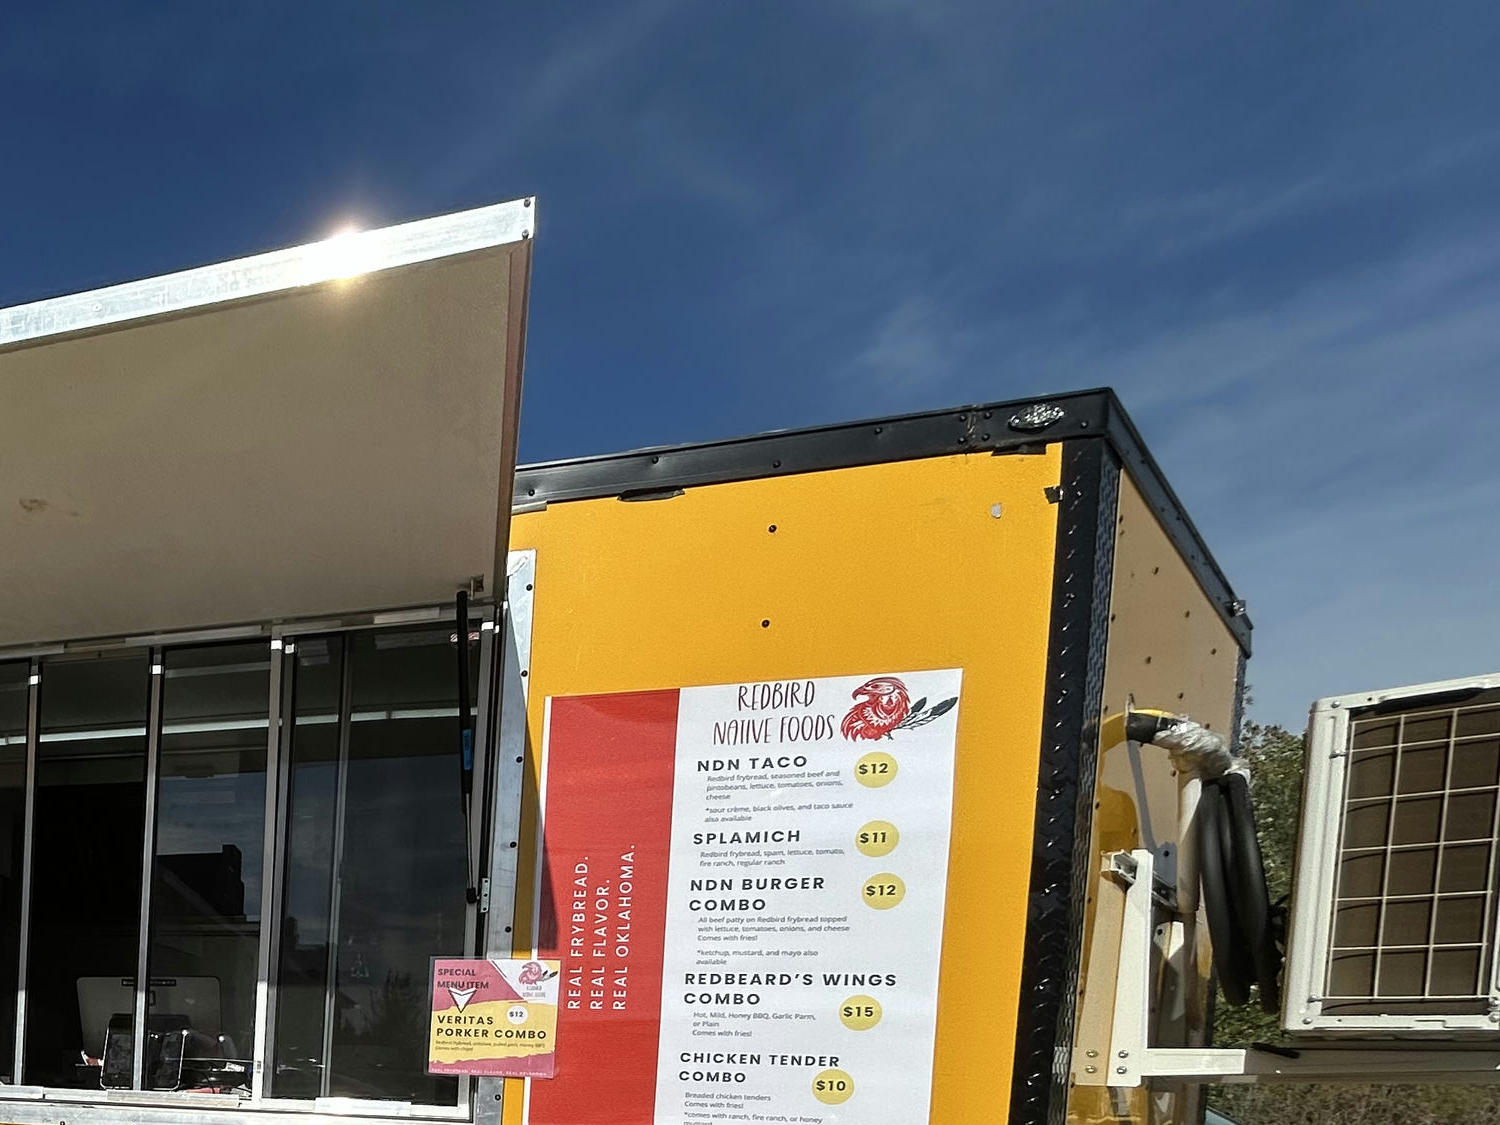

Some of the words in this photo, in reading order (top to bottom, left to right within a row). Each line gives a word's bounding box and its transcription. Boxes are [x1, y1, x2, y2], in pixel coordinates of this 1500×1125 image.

[738, 681, 815, 711] REDBIRD
[714, 719, 773, 745] NATIVE
[780, 715, 835, 743] FOODS
[698, 759, 740, 772] NDN
[749, 756, 807, 769] TACO
[859, 763, 888, 775] $12
[694, 830, 800, 845] SPLAMICH
[860, 832, 886, 844] $11
[691, 879, 732, 891] NDN
[742, 877, 824, 890] BURGER
[866, 885, 896, 897] $12
[571, 856, 589, 957] FRYBREAD.
[616, 845, 635, 957] OKLAHOMA.
[689, 899, 766, 911] COMBO
[593, 879, 610, 957] FLAVOR.
[438, 968, 476, 977] SPECIAL
[438, 981, 464, 989] MENU
[466, 981, 489, 989] ITEM
[685, 973, 813, 986] REDBEARD'S
[823, 974, 896, 986] WINGS
[568, 966, 583, 1009] REAL
[590, 966, 605, 1009] REAL
[613, 966, 628, 1010] REAL
[684, 993, 760, 1005] COMBO
[844, 1006, 873, 1018] $15
[438, 1015, 494, 1025] VERITAS
[437, 1028, 489, 1038] PORKER
[495, 1030, 546, 1040] COMBO
[680, 1053, 761, 1065] CHICKEN
[769, 1055, 839, 1067] TENDER
[679, 1071, 746, 1083] COMBO
[816, 1080, 846, 1092] $10
